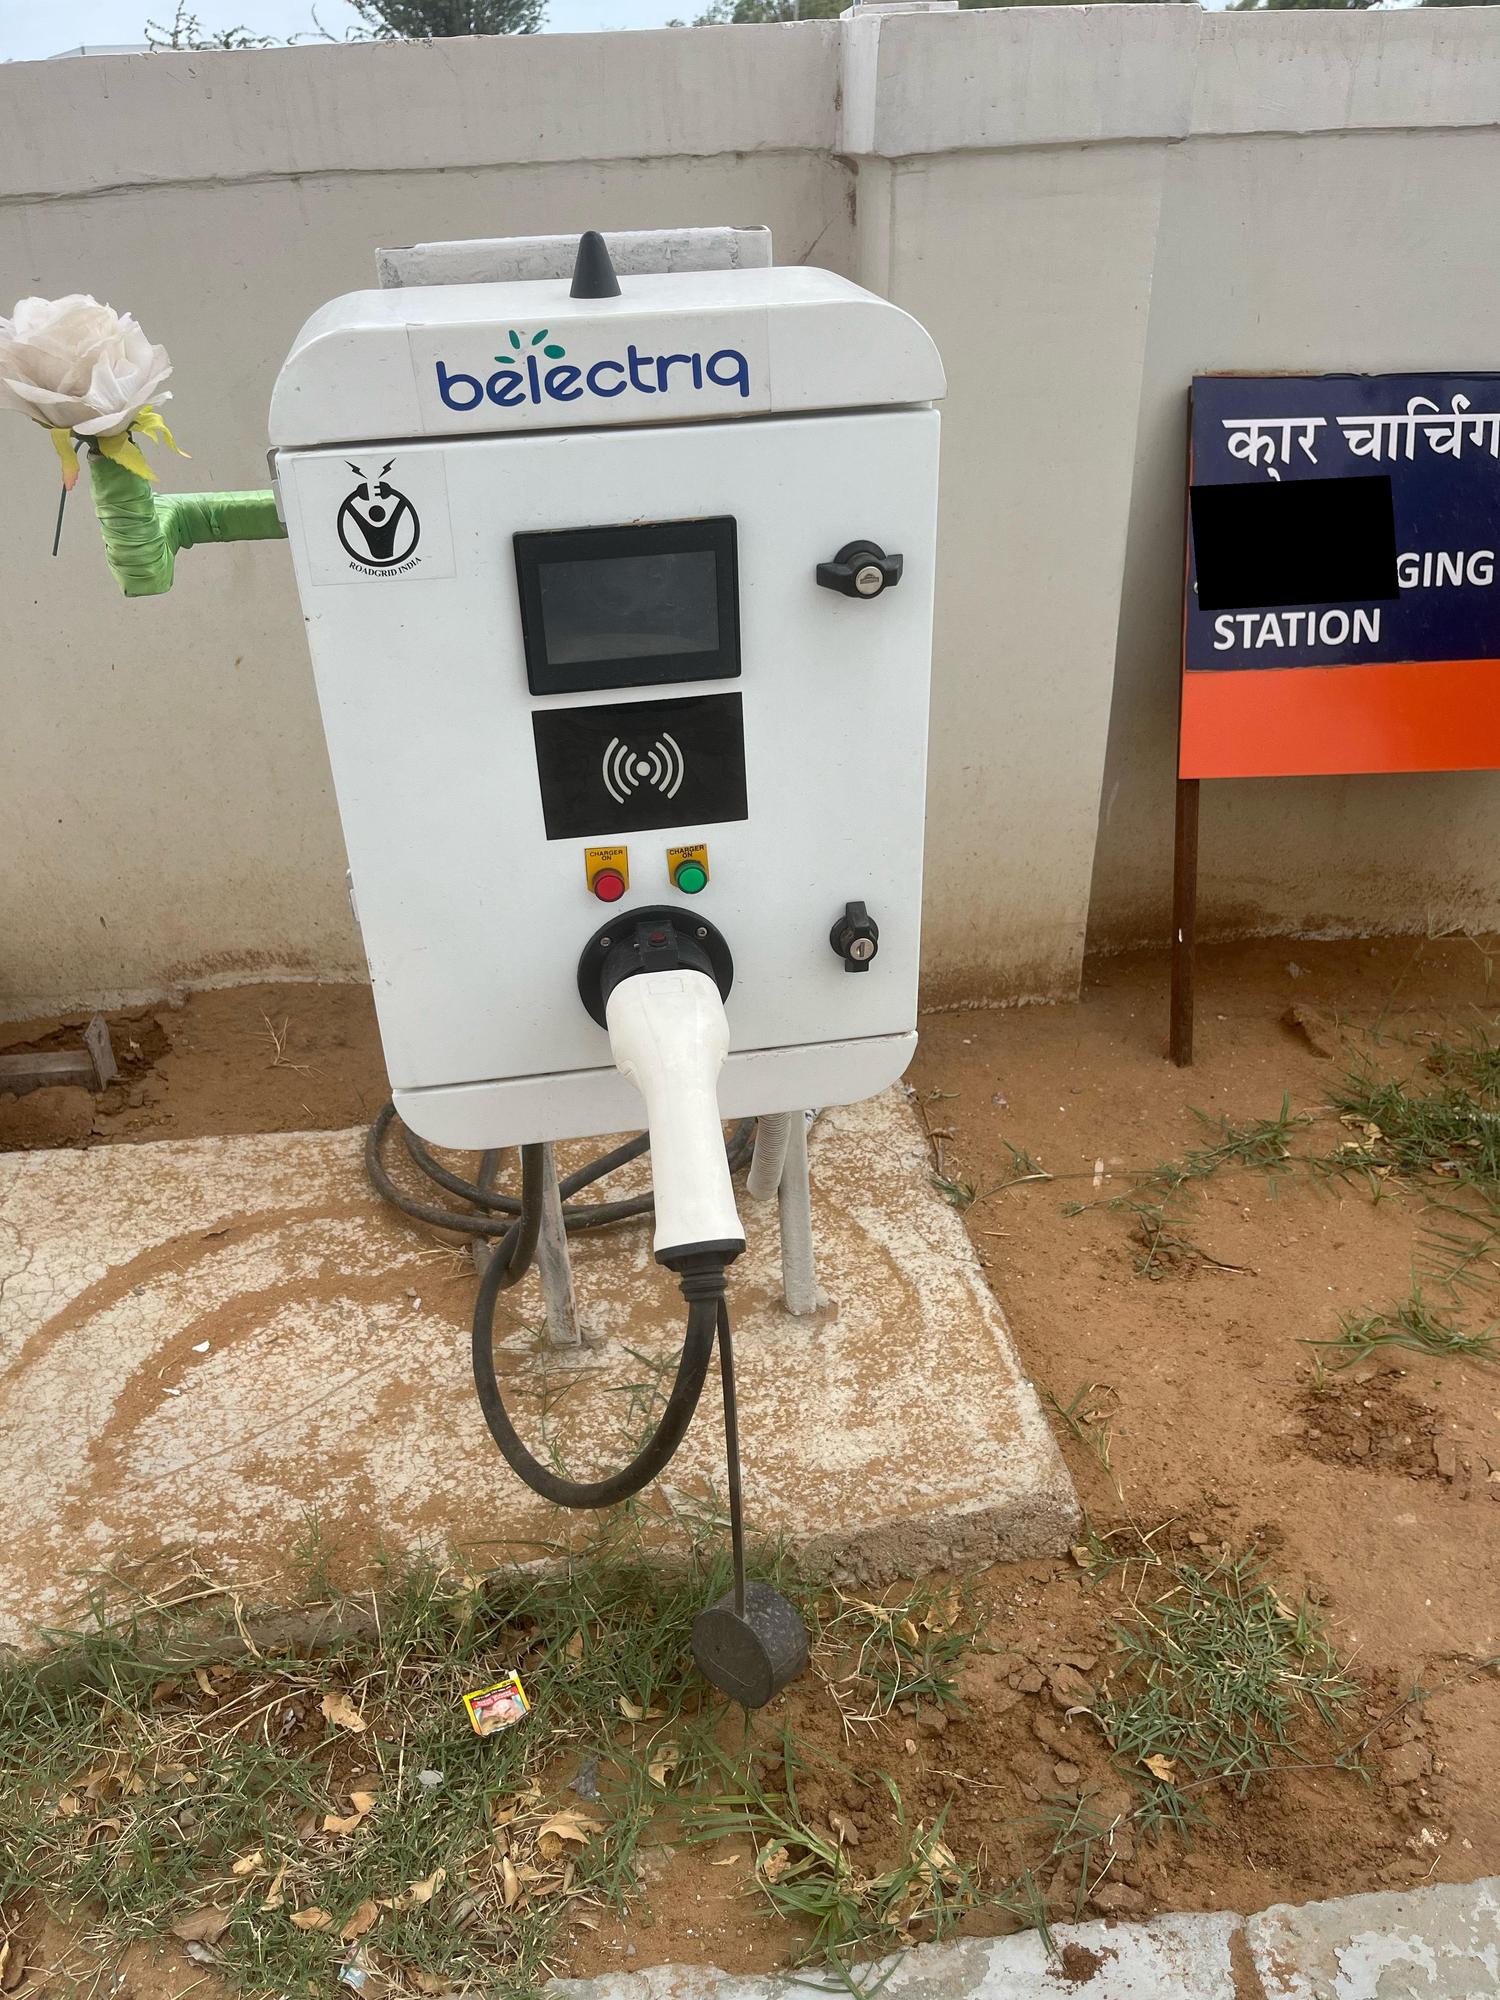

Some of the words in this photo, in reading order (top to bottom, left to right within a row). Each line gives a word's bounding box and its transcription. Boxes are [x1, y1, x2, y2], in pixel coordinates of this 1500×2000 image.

[435, 343, 750, 411] belectriq
[1222, 417, 1327, 466] कार
[349, 561, 397, 577] ROADGRID
[398, 556, 422, 574] INDIA
[1396, 550, 1495, 588] GING
[1213, 608, 1381, 651] STATION
[589, 849, 623, 857] CHARGER
[669, 844, 705, 855] CHARGER
[682, 851, 693, 859] ON
